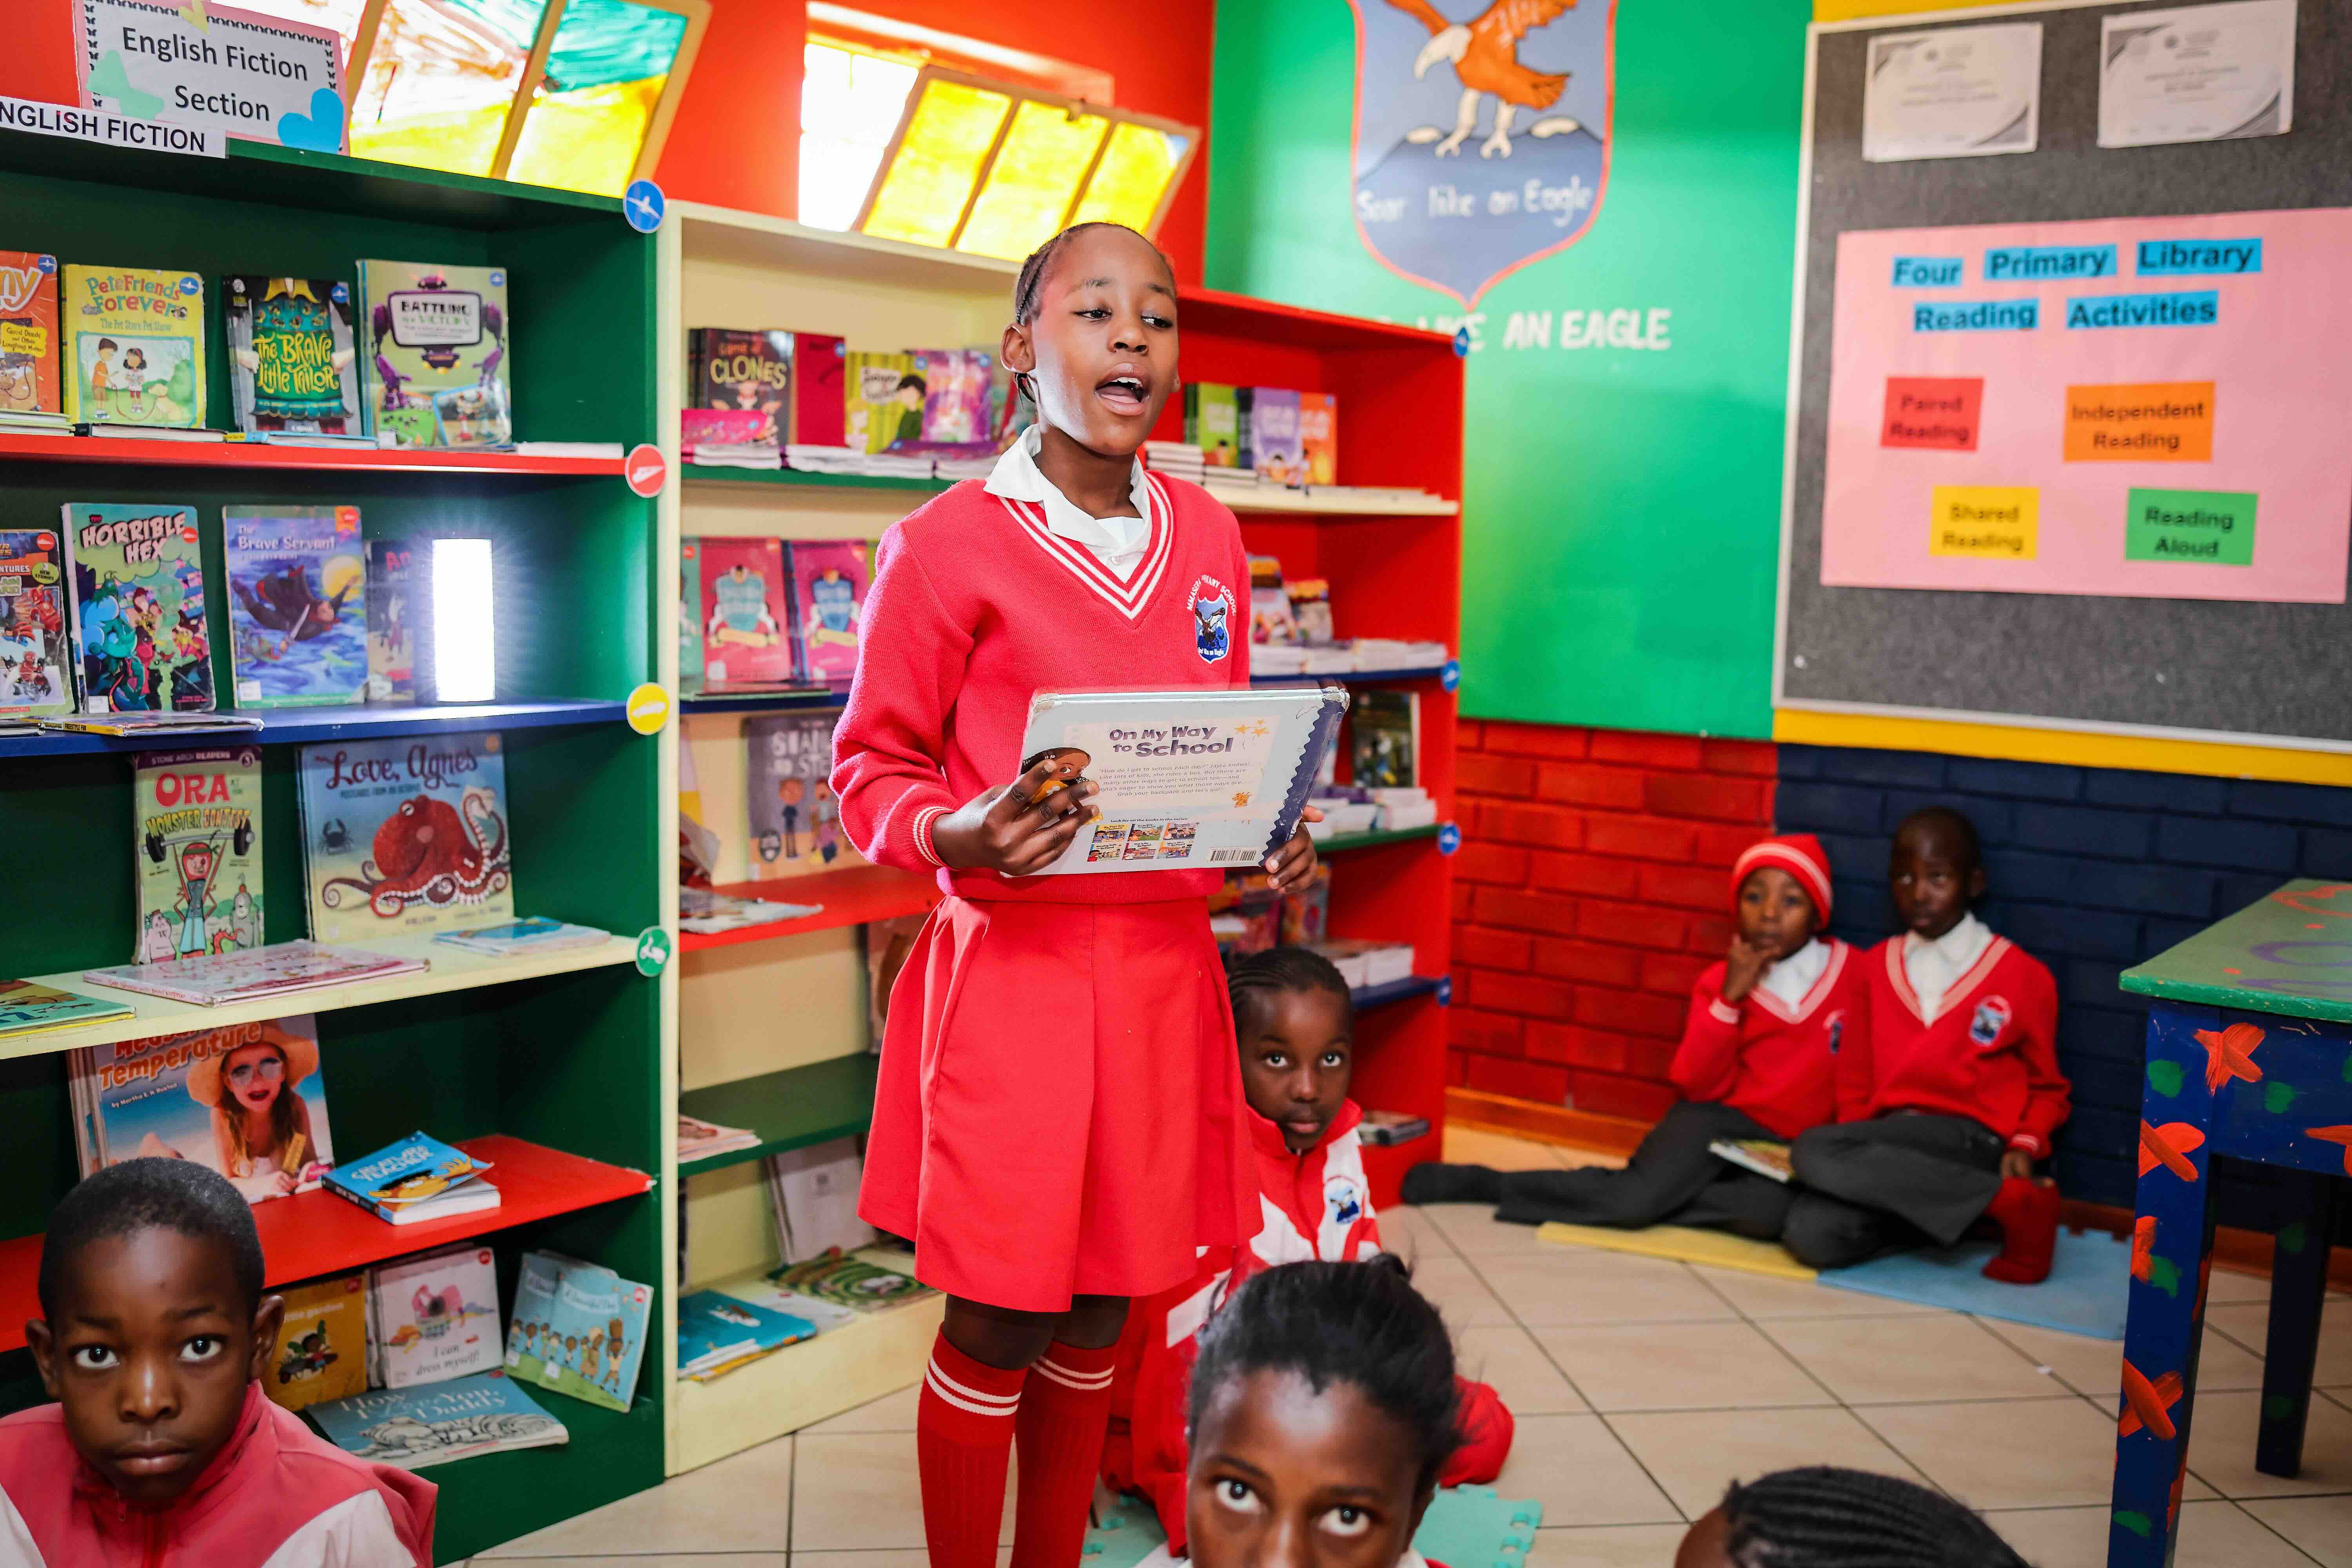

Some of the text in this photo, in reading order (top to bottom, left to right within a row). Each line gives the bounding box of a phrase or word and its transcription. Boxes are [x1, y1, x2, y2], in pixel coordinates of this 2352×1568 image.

[123, 26, 309, 82] English Fiction
[175, 85, 270, 122] Section
[108, 118, 205, 152] FICTION
[1428, 183, 1475, 218] like
[1487, 190, 1518, 215] an
[1523, 174, 1594, 227] Eagle
[1892, 241, 2255, 286] Four Primary Library
[85, 276, 181, 301] Pet Friends
[93, 295, 177, 317] Forever
[1914, 296, 2215, 332] Reading Activities
[100, 318, 112, 329] The
[1503, 310, 1553, 350] AN
[1559, 307, 1672, 351] EAGLE
[252, 332, 278, 362] The
[710, 355, 787, 390] CLONES
[1900, 394, 1965, 413] Paired
[2071, 401, 2205, 423] Independent
[1889, 422, 1969, 446] Reading
[2092, 432, 2181, 454] Reading
[1949, 502, 2021, 524] Shared
[2145, 506, 2234, 533] Reading
[80, 511, 185, 549] HORRIBLE
[238, 524, 256, 534] The
[123, 537, 167, 565] HEX
[238, 535, 336, 551] Brave Servant
[1942, 531, 2025, 555] Reading
[2153, 536, 2219, 559] Aloud
[1220, 585, 1237, 617] SCHOOL
[1109, 726, 1217, 741] On My Way
[1113, 738, 1234, 757] to School
[314, 744, 479, 790] Love, Agnes
[154, 772, 231, 808] ORA
[145, 808, 252, 838] MONSTER CONTEST
[100, 1022, 263, 1091] Temperature
[111, 1101, 120, 1109] by
